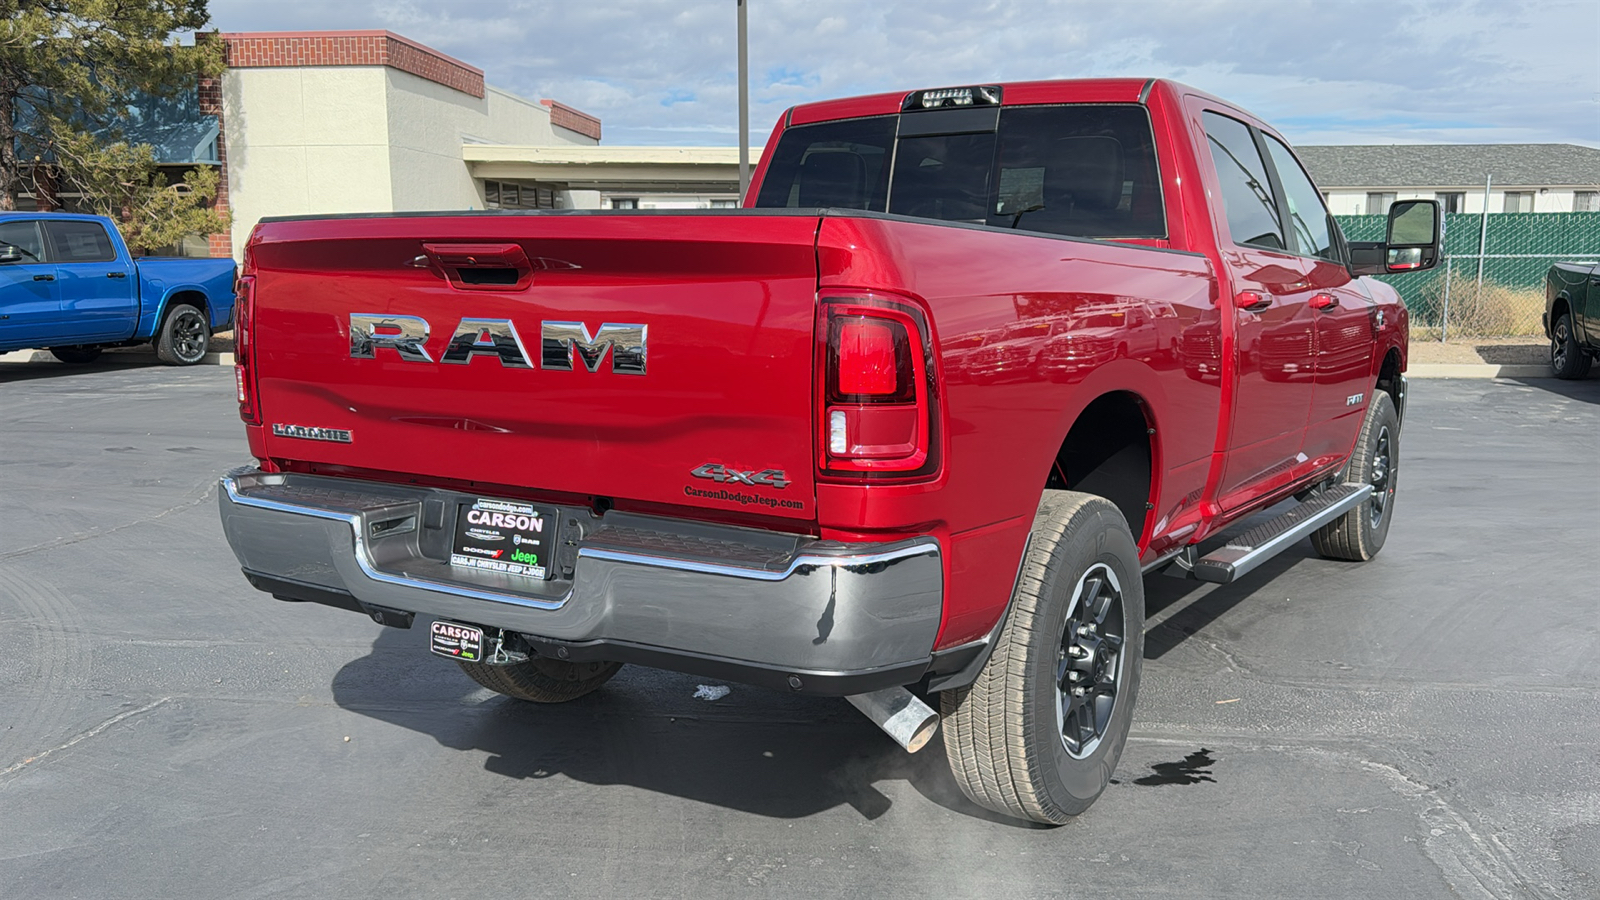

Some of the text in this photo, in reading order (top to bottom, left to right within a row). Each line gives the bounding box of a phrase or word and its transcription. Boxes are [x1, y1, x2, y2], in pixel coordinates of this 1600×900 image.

[350, 313, 648, 375] RAM
[273, 424, 353, 442] LARAMIE
[684, 485, 804, 509] CarsonDodgeJeep.com
[479, 501, 532, 514] carsondodge.com
[467, 510, 543, 532] CARSON
[463, 546, 498, 555] DODGE
[511, 548, 538, 566] Jeep
[507, 564, 522, 573] JEEP
[433, 624, 479, 642] CARSON
